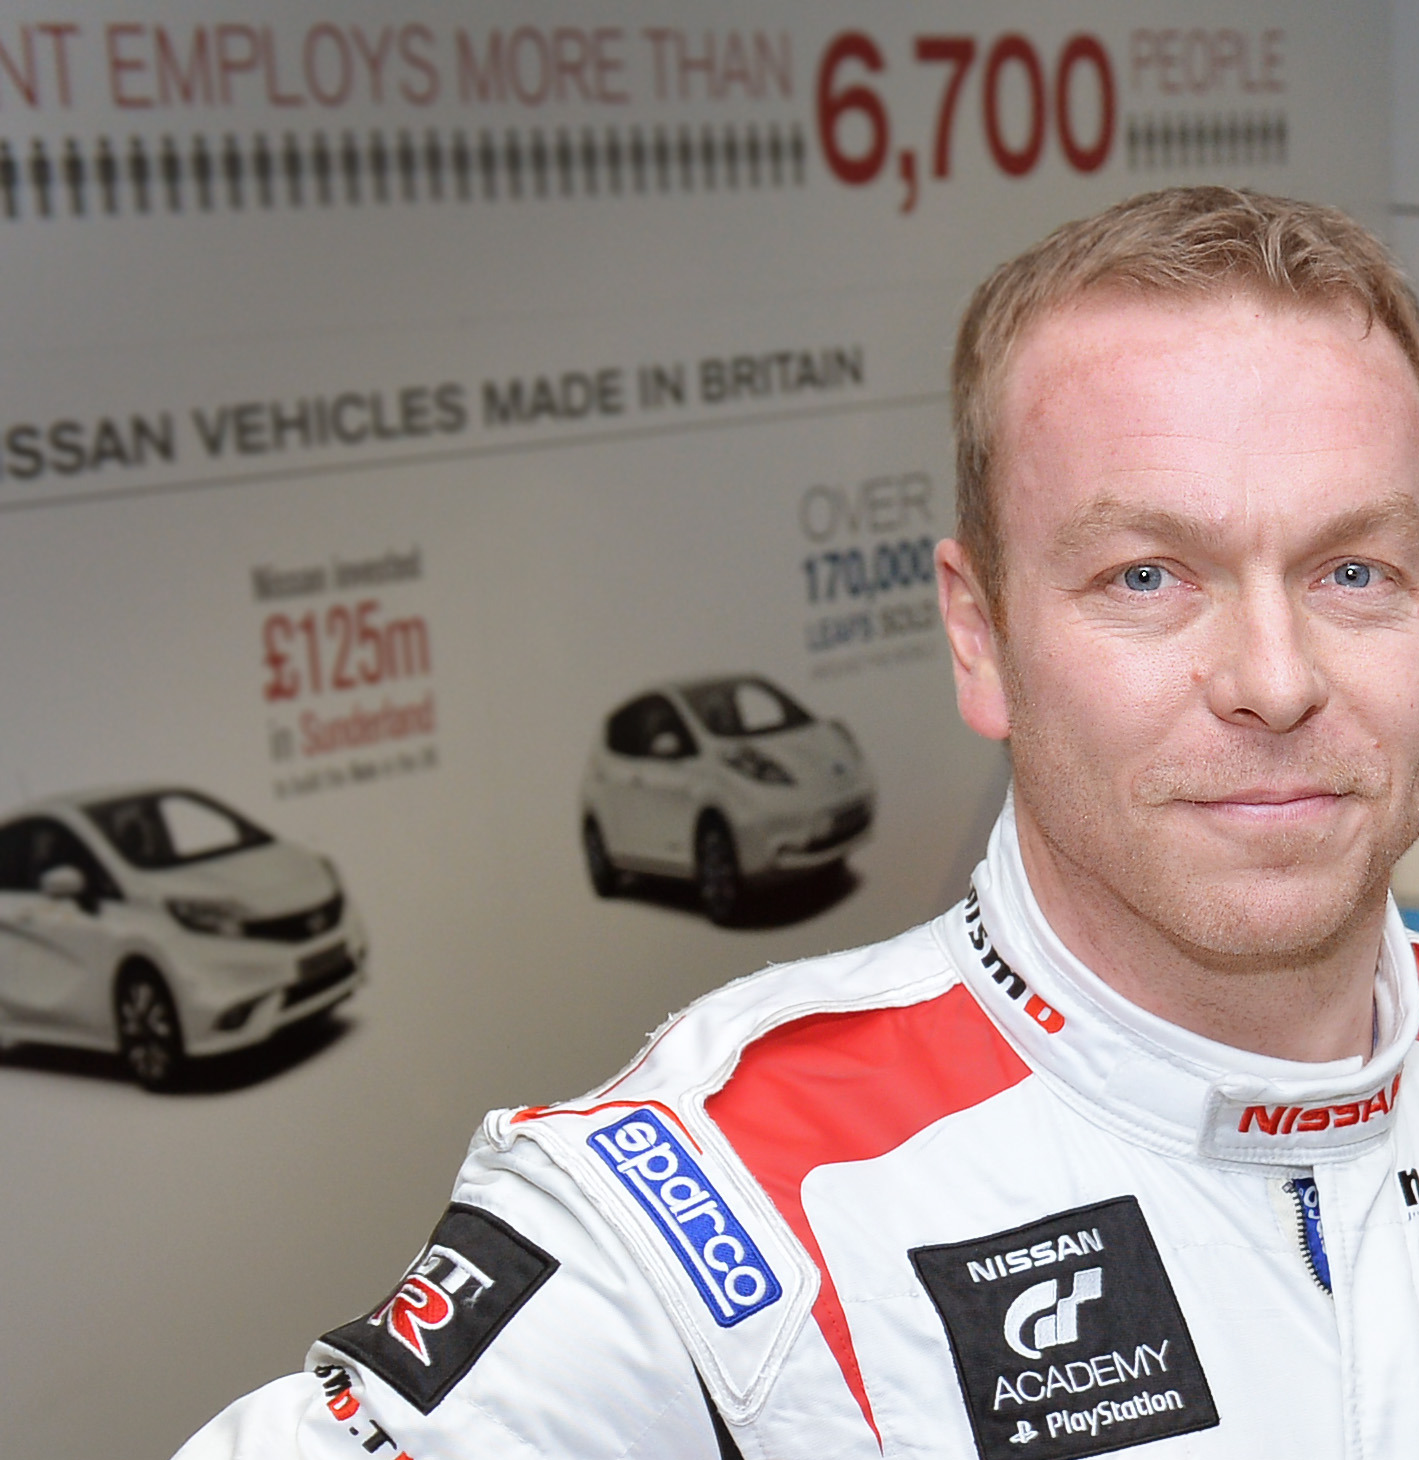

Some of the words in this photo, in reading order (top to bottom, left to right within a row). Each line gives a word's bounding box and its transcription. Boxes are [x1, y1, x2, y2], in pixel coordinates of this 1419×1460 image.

[104, 22, 441, 111] EMPLOYS
[455, 25, 633, 107] MORE
[640, 27, 794, 103] THAN
[815, 31, 1117, 213] 6,700
[1129, 28, 1289, 97] PEOPLE
[0, 410, 176, 482] SSAN
[190, 380, 468, 459] VEHICLES
[482, 366, 624, 427] MADE
[637, 362, 686, 408] IN
[699, 344, 866, 403] BRITAIN
[799, 470, 935, 543] OVER
[261, 598, 431, 701] £125m
[300, 692, 436, 757] Sunderland
[612, 1119, 767, 1308] sparco
[967, 1227, 1105, 1283] NISSAN
[993, 1338, 1170, 1412] ACADEMY
[1046, 1388, 1184, 1438] PlayStation
